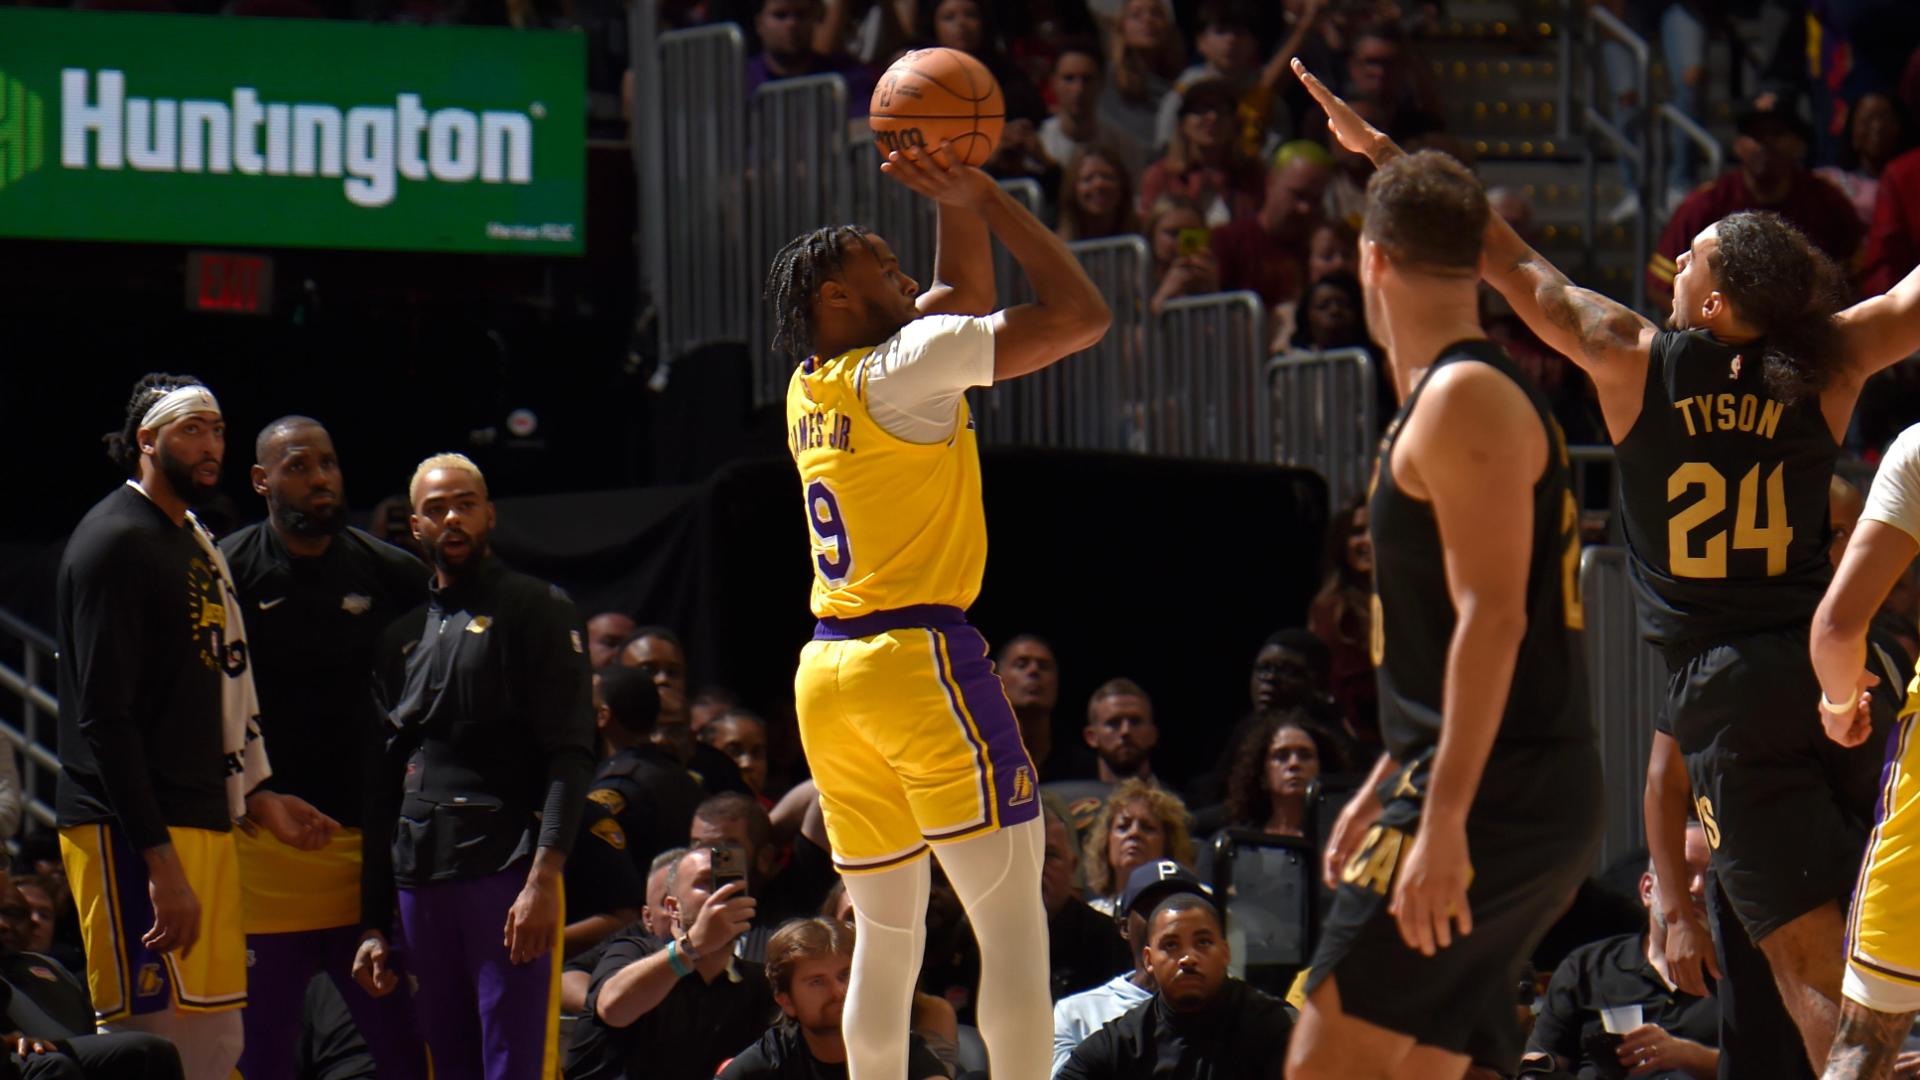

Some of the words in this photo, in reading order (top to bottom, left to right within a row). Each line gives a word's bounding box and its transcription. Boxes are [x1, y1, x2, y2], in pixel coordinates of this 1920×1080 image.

[61, 68, 532, 207] Huntington
[829, 412, 855, 453] JR.
[1674, 393, 1785, 440] TYSON
[807, 478, 856, 590] 9
[1667, 461, 1794, 579] 24
[1157, 860, 1178, 881] P
[1342, 824, 1408, 896] CA
